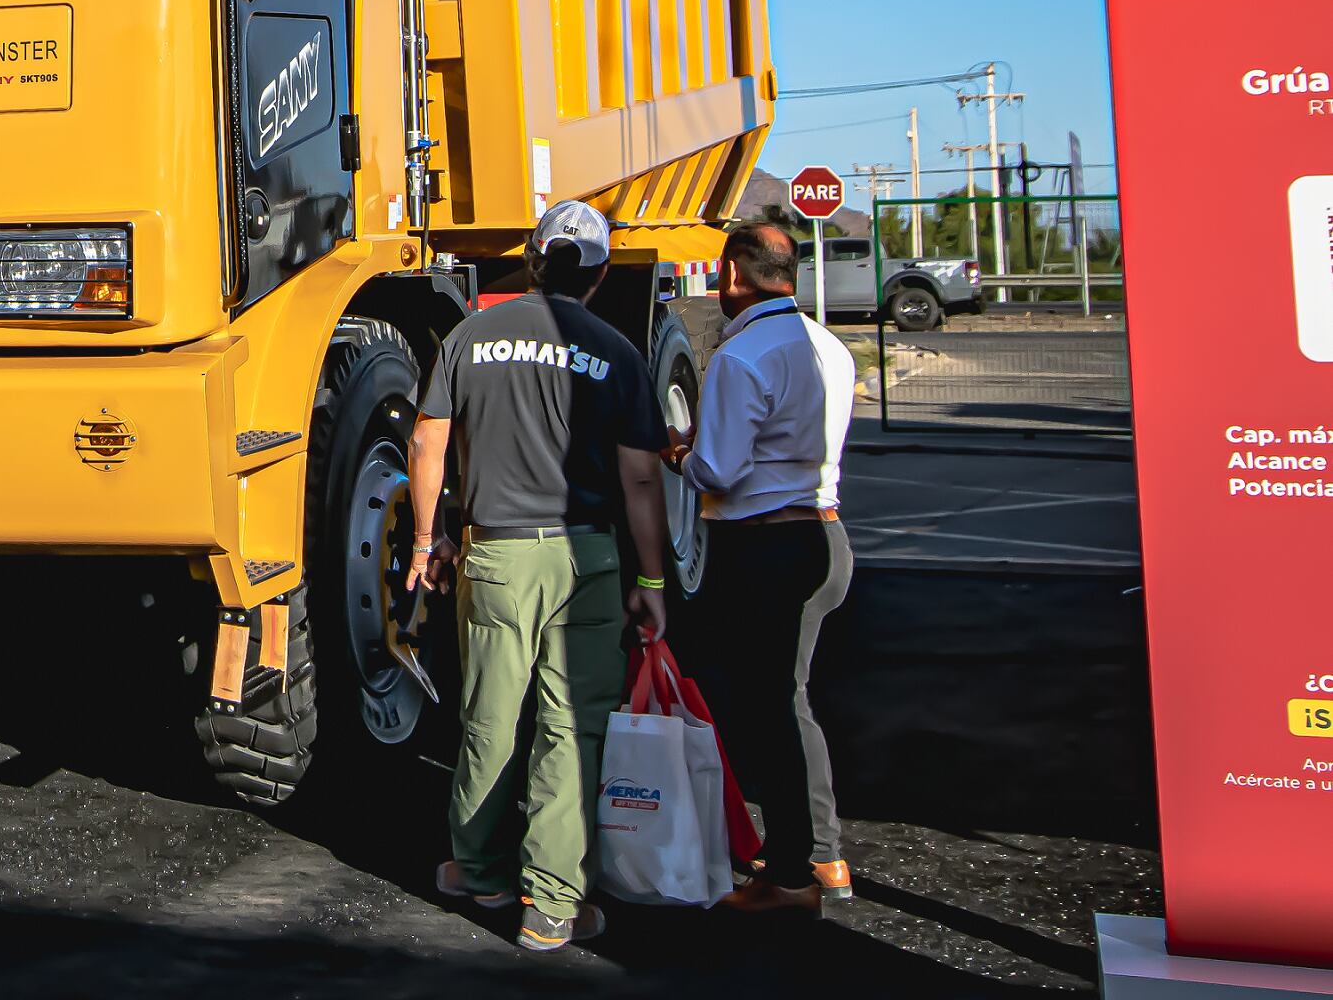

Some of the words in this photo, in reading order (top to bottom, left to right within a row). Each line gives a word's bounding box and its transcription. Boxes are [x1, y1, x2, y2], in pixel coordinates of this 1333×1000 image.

[20, 73, 59, 84] SKT90S
[1241, 64, 1330, 96] Grúa
[257, 31, 322, 158] SANY
[793, 183, 841, 201] PARE
[562, 225, 579, 236] CAT
[471, 338, 611, 382] KOMATSU
[1225, 425, 1282, 447] Cap.
[1228, 452, 1327, 470] Alcance
[1228, 477, 1333, 498] Potencia
[1223, 771, 1301, 790] Acércate
[1305, 779, 1316, 790] a
